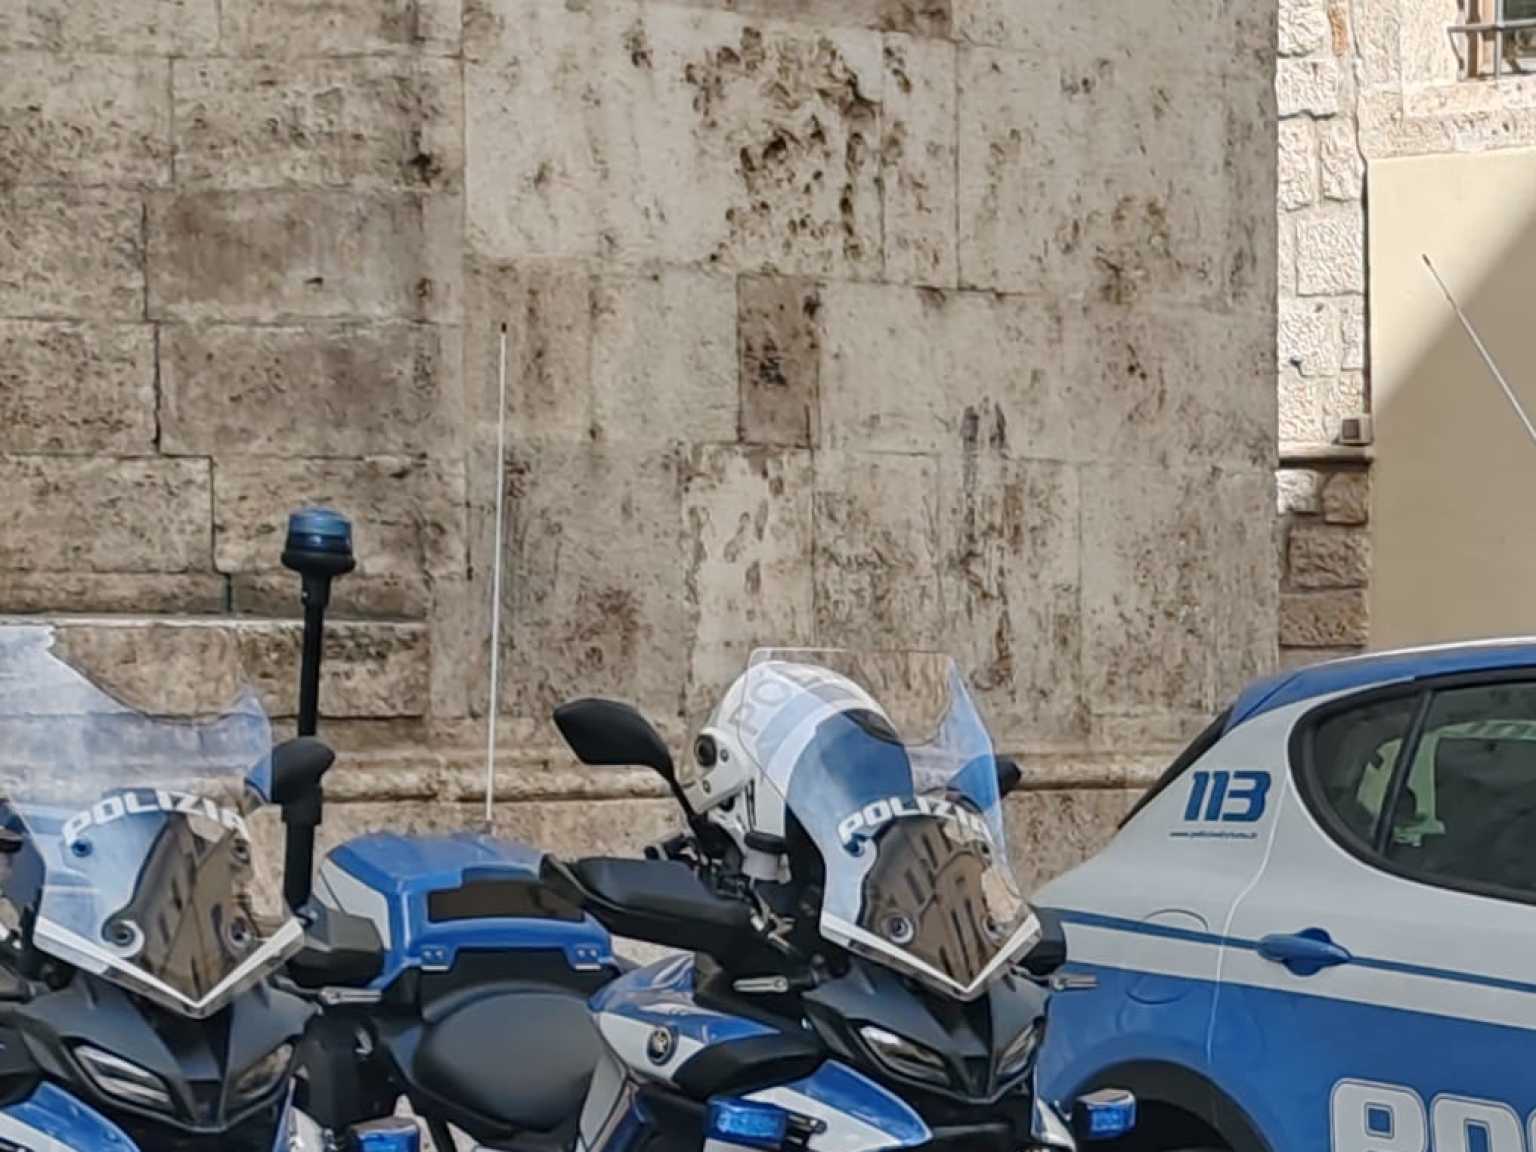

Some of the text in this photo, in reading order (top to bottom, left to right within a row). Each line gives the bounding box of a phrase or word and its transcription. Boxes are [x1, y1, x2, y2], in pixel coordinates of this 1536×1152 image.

[62, 791, 251, 847] POLIZIA
[1184, 771, 1271, 822] 113
[838, 797, 995, 850] POLIZIA
